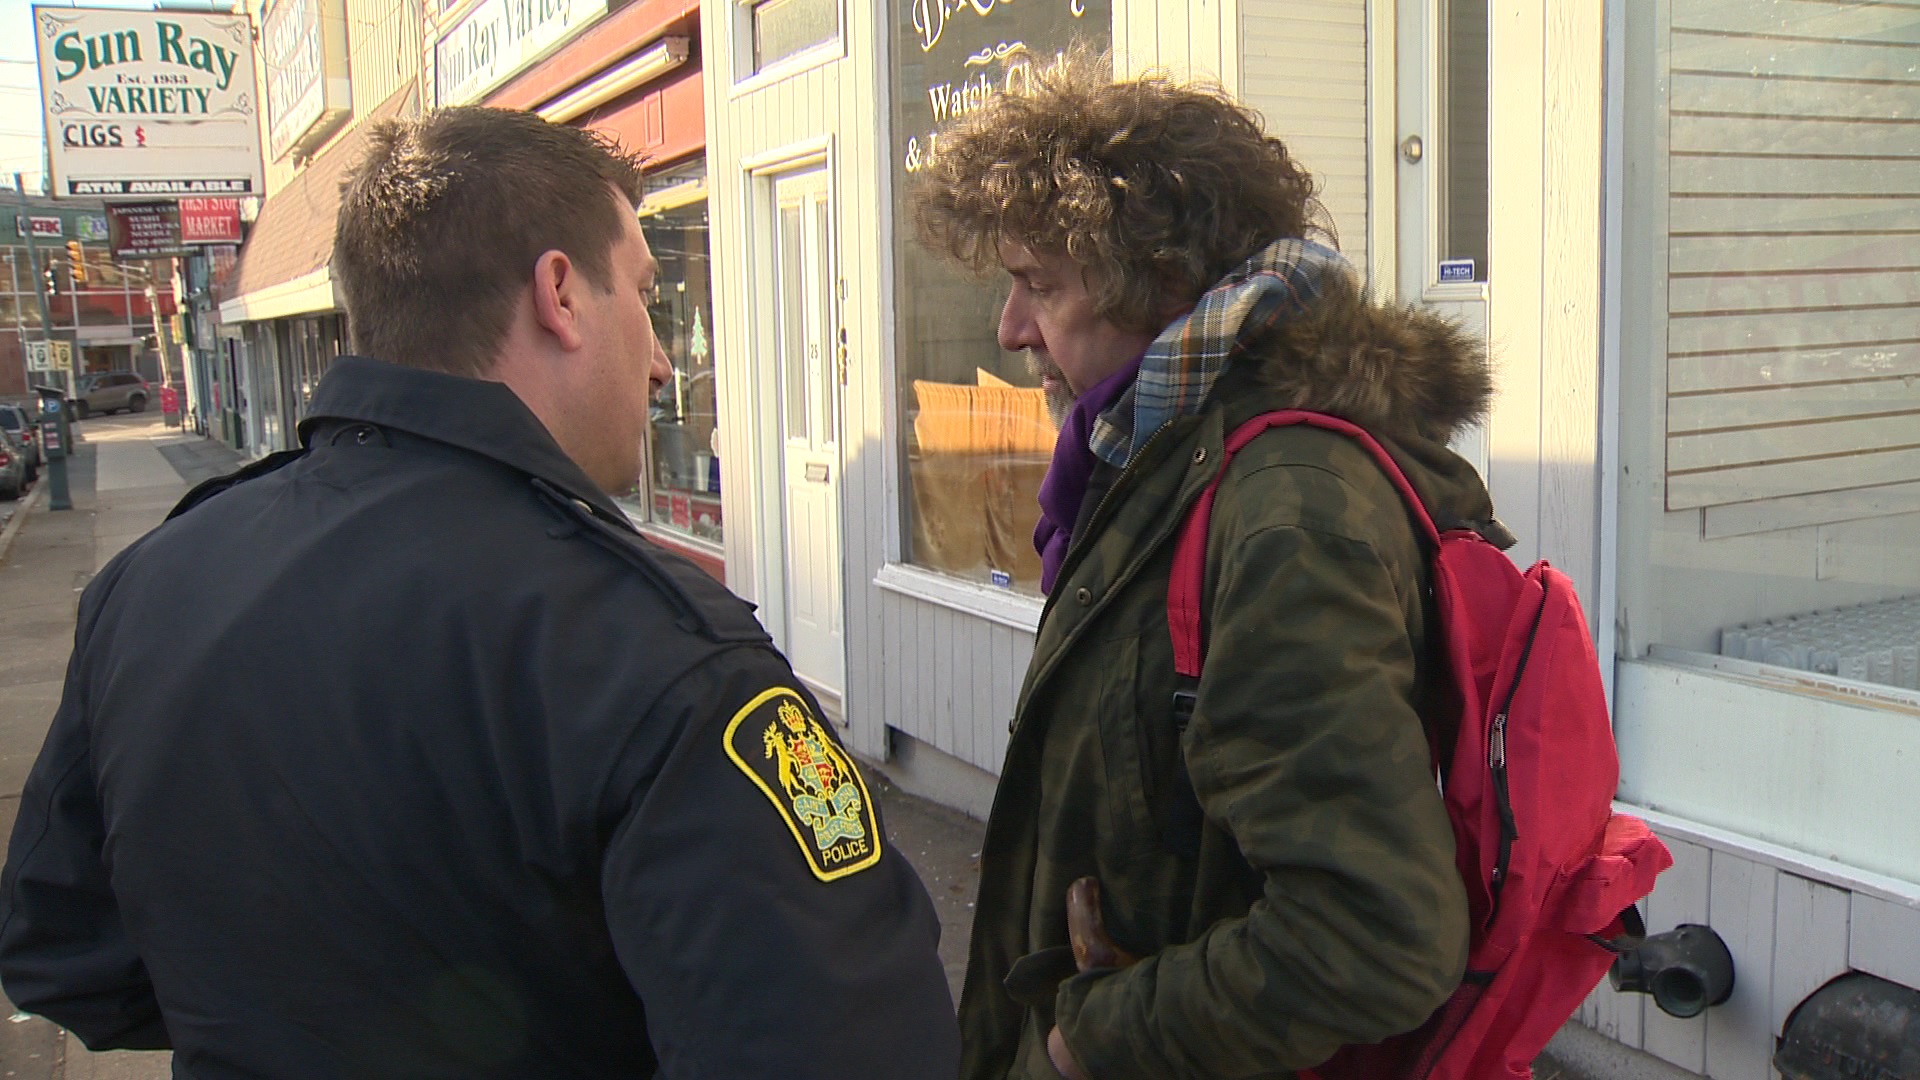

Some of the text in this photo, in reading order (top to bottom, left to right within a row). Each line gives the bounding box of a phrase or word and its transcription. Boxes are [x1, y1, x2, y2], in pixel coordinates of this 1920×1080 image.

[54, 28, 143, 83] Sun
[156, 20, 239, 91] Ray
[468, 18, 499, 78] Ray
[116, 73, 146, 84] Est.
[88, 86, 212, 114] VARIETY
[928, 73, 992, 123] Watch
[64, 124, 146, 146] CIGS $
[906, 136, 922, 173] &
[76, 180, 245, 193] ATM AVAILABLE
[186, 216, 232, 236] MARKET
[1444, 266, 1471, 276] HI-TECH
[811, 344, 819, 359] 25
[822, 839, 869, 868] POLICE
